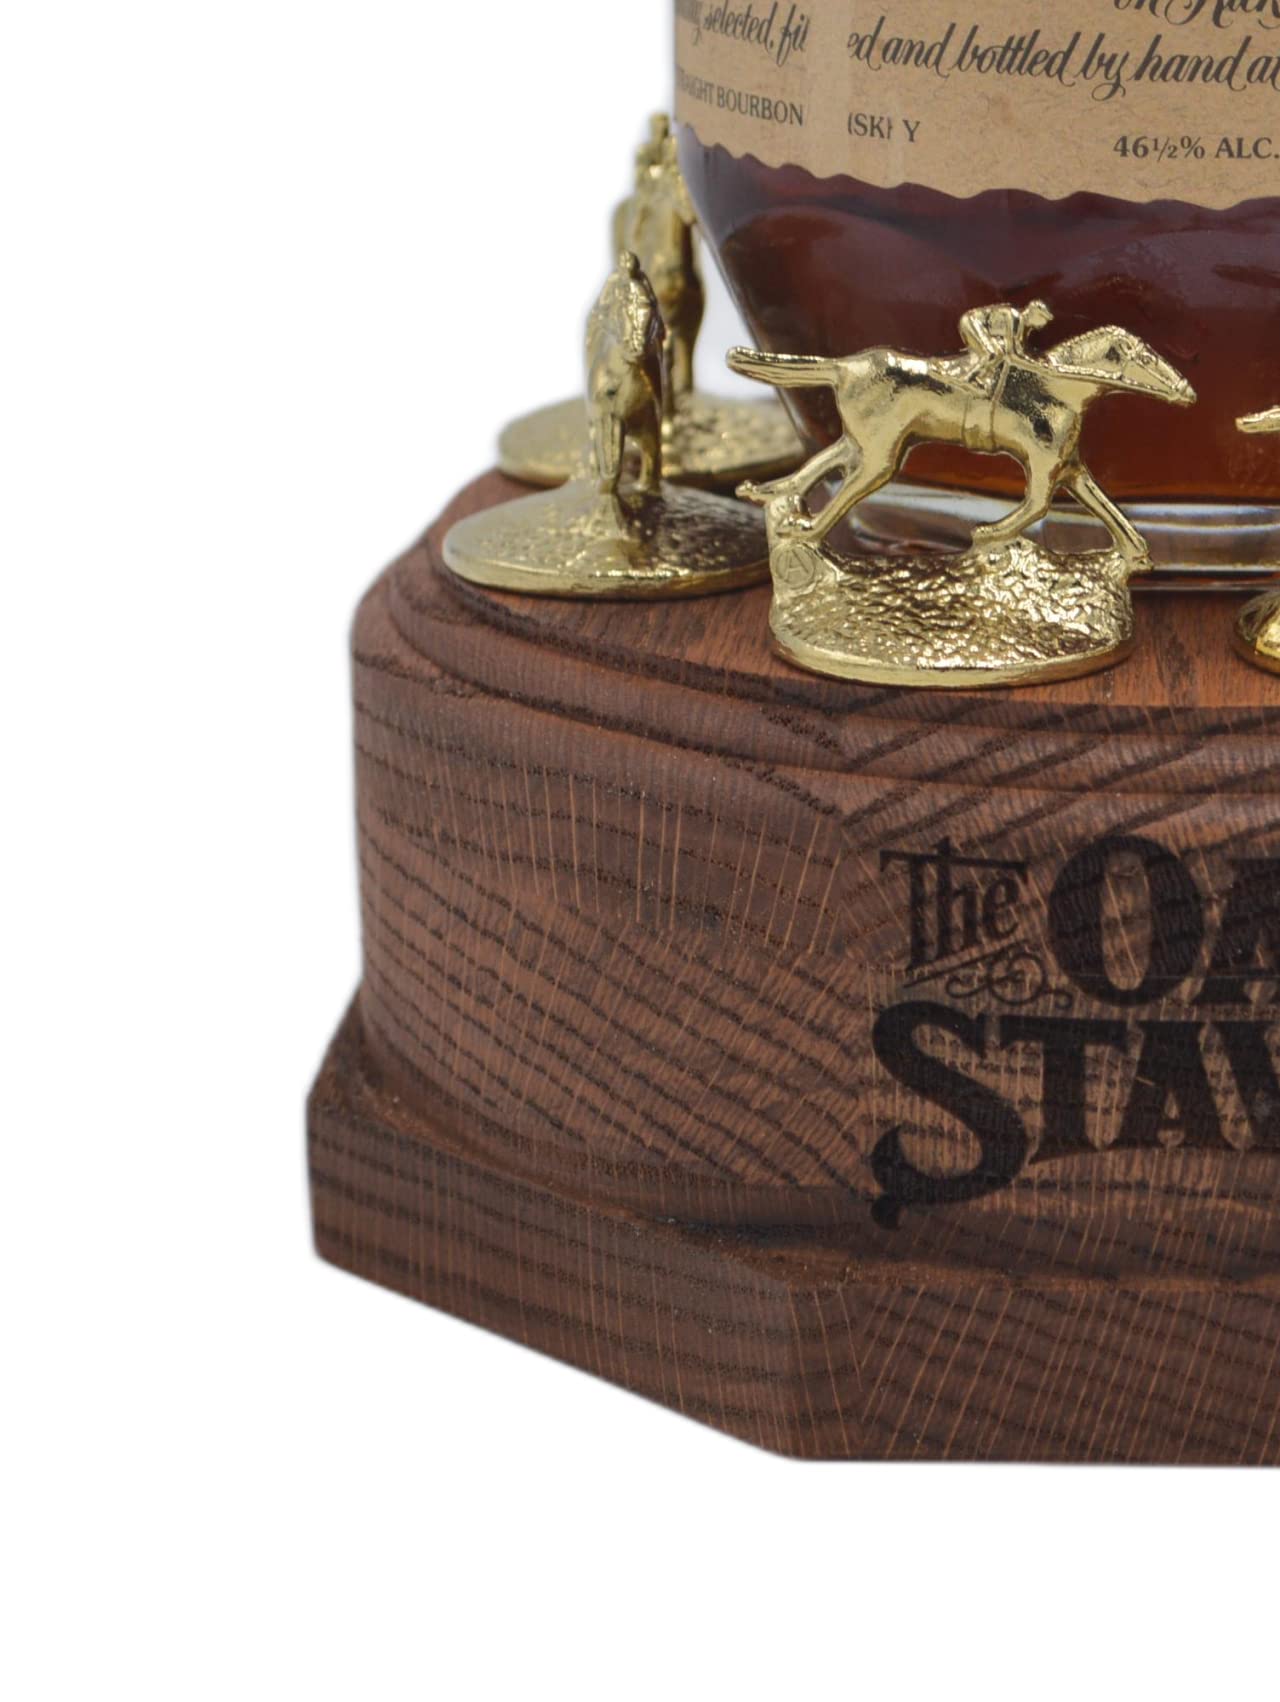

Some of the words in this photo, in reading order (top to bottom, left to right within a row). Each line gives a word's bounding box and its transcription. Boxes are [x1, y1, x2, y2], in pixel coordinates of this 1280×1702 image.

[881, 22, 956, 78] and
[950, 25, 1076, 87] bottled
[1076, 32, 1127, 101] by
[1127, 34, 1248, 92] hand
[716, 85, 803, 126] BOURBON
[879, 836, 1029, 973] The
